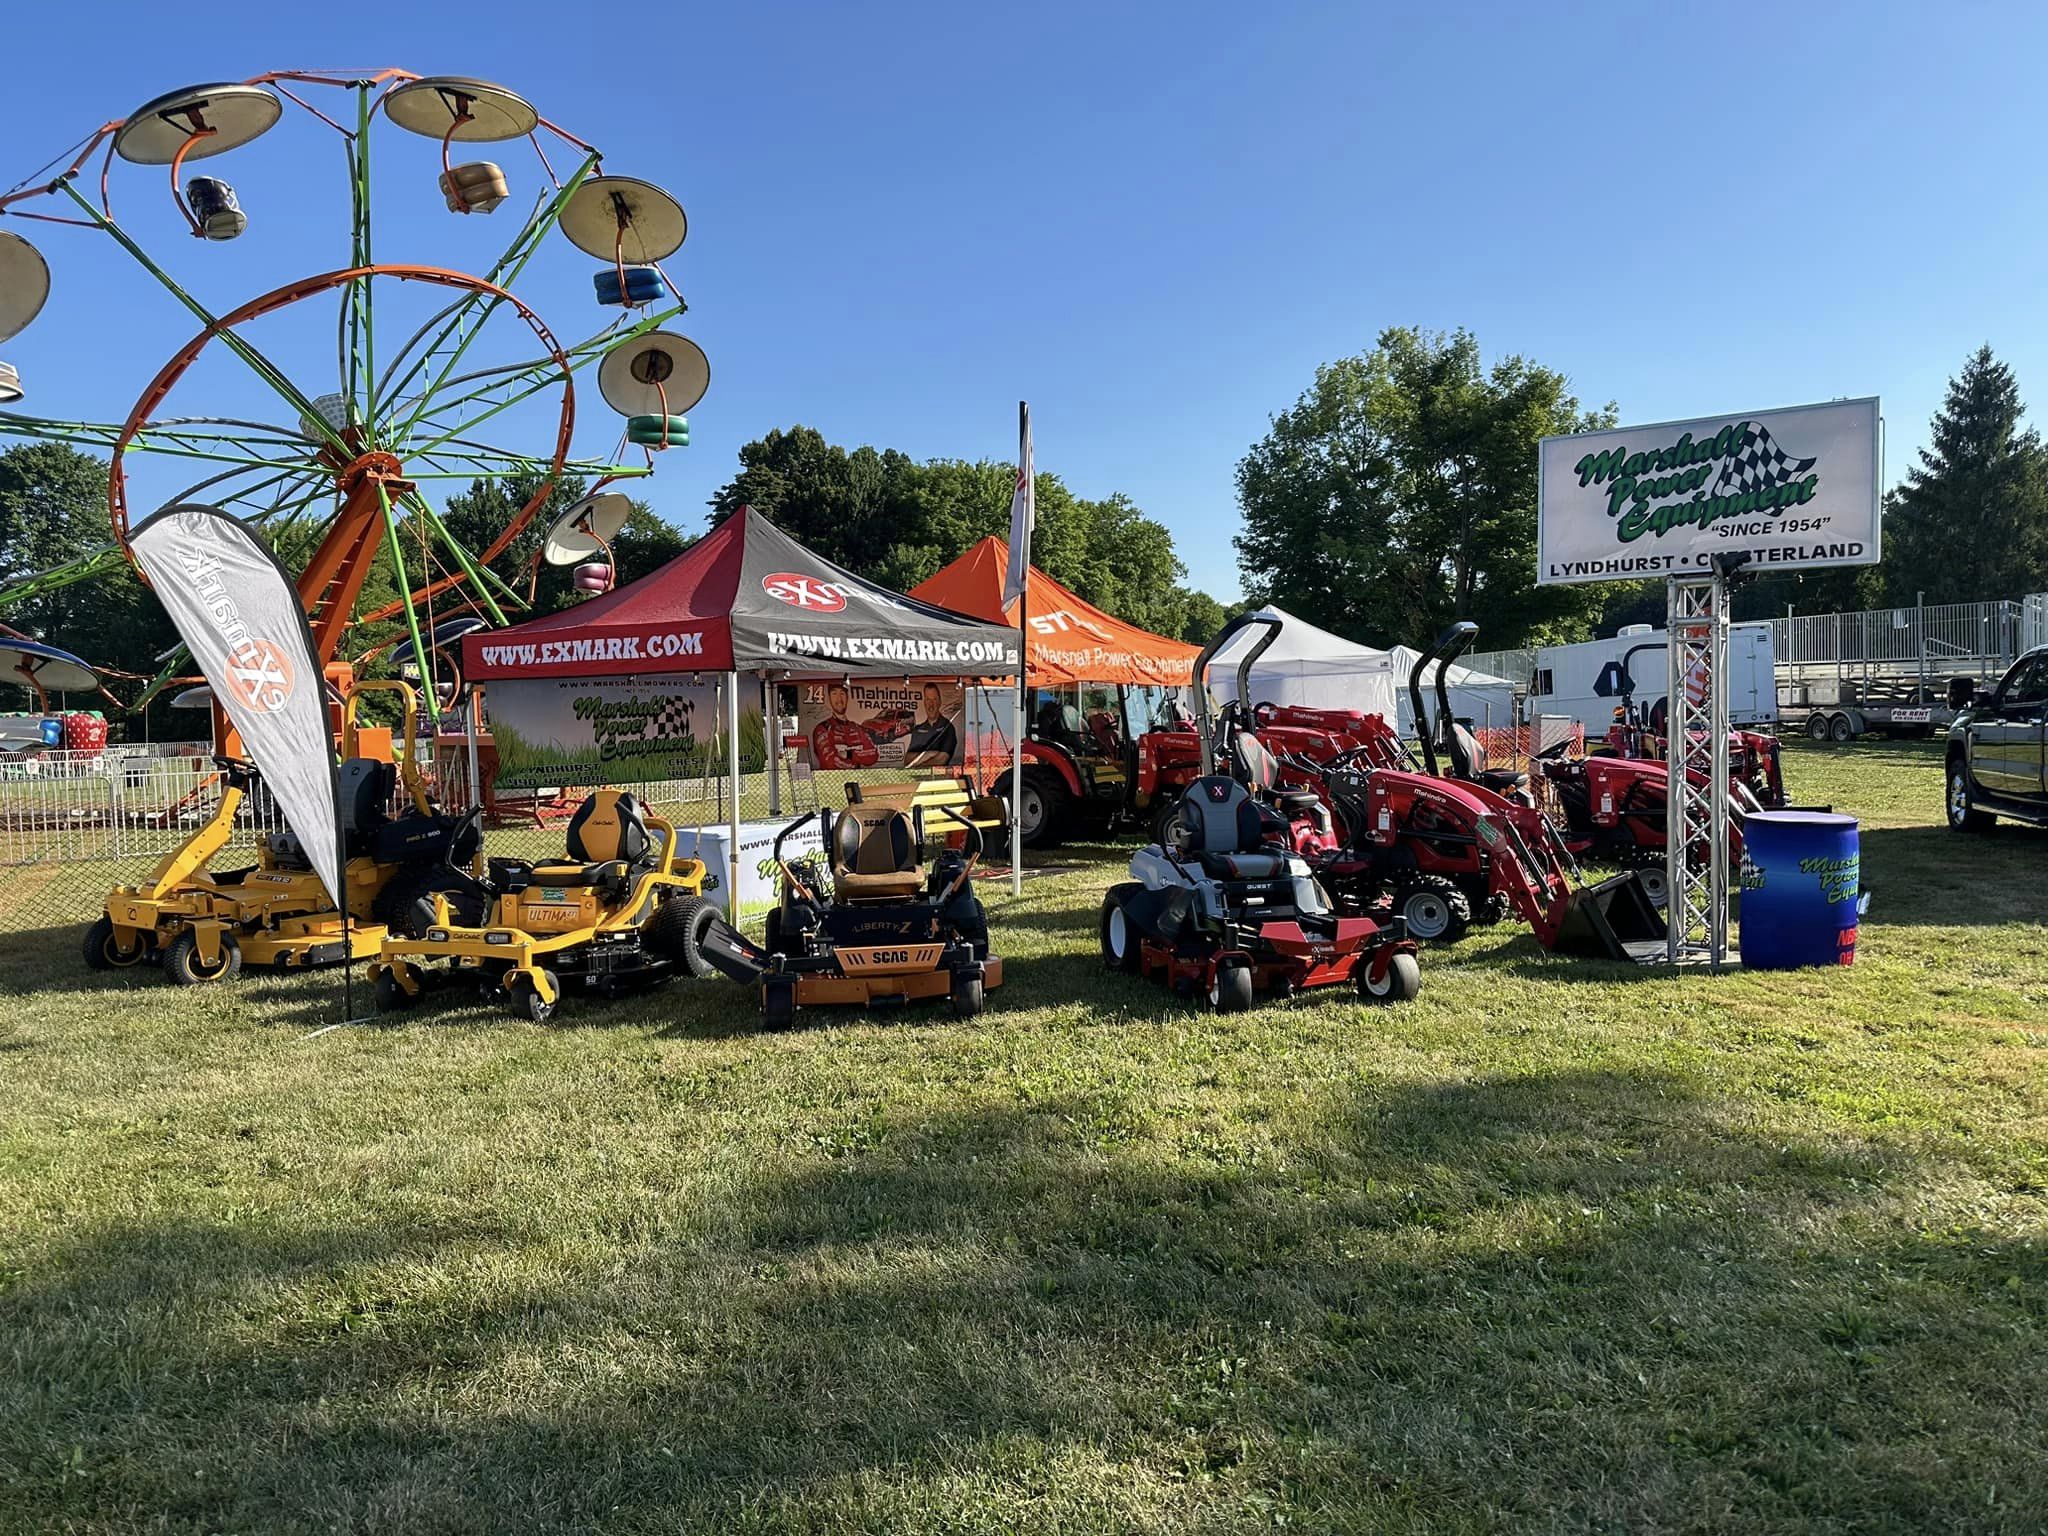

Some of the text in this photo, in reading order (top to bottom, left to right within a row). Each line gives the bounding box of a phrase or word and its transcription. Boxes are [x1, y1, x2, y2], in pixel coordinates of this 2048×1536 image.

[1574, 422, 1749, 487] Marshall
[1605, 463, 1713, 516] Power
[1617, 474, 1817, 543] Equipment
[1550, 542, 1865, 577] LYNDHURST CSTERLAND
[481, 632, 703, 666] WWW.EXMARK.COM
[767, 632, 1004, 663] WWW.EXMARK.COM
[1093, 646, 1131, 668] Power
[803, 686, 825, 704] 14
[851, 687, 922, 701] Mahindra
[857, 701, 918, 710] TRACTORS
[573, 695, 665, 721] Marshall
[593, 717, 648, 743] Power
[600, 733, 695, 761] Equipment
[1414, 788, 1447, 803] Mahindra
[863, 819, 886, 827] SCAG
[529, 910, 567, 921] ULTIMA
[854, 921, 912, 934] LIBERTY Z
[872, 951, 909, 964] SCAG
